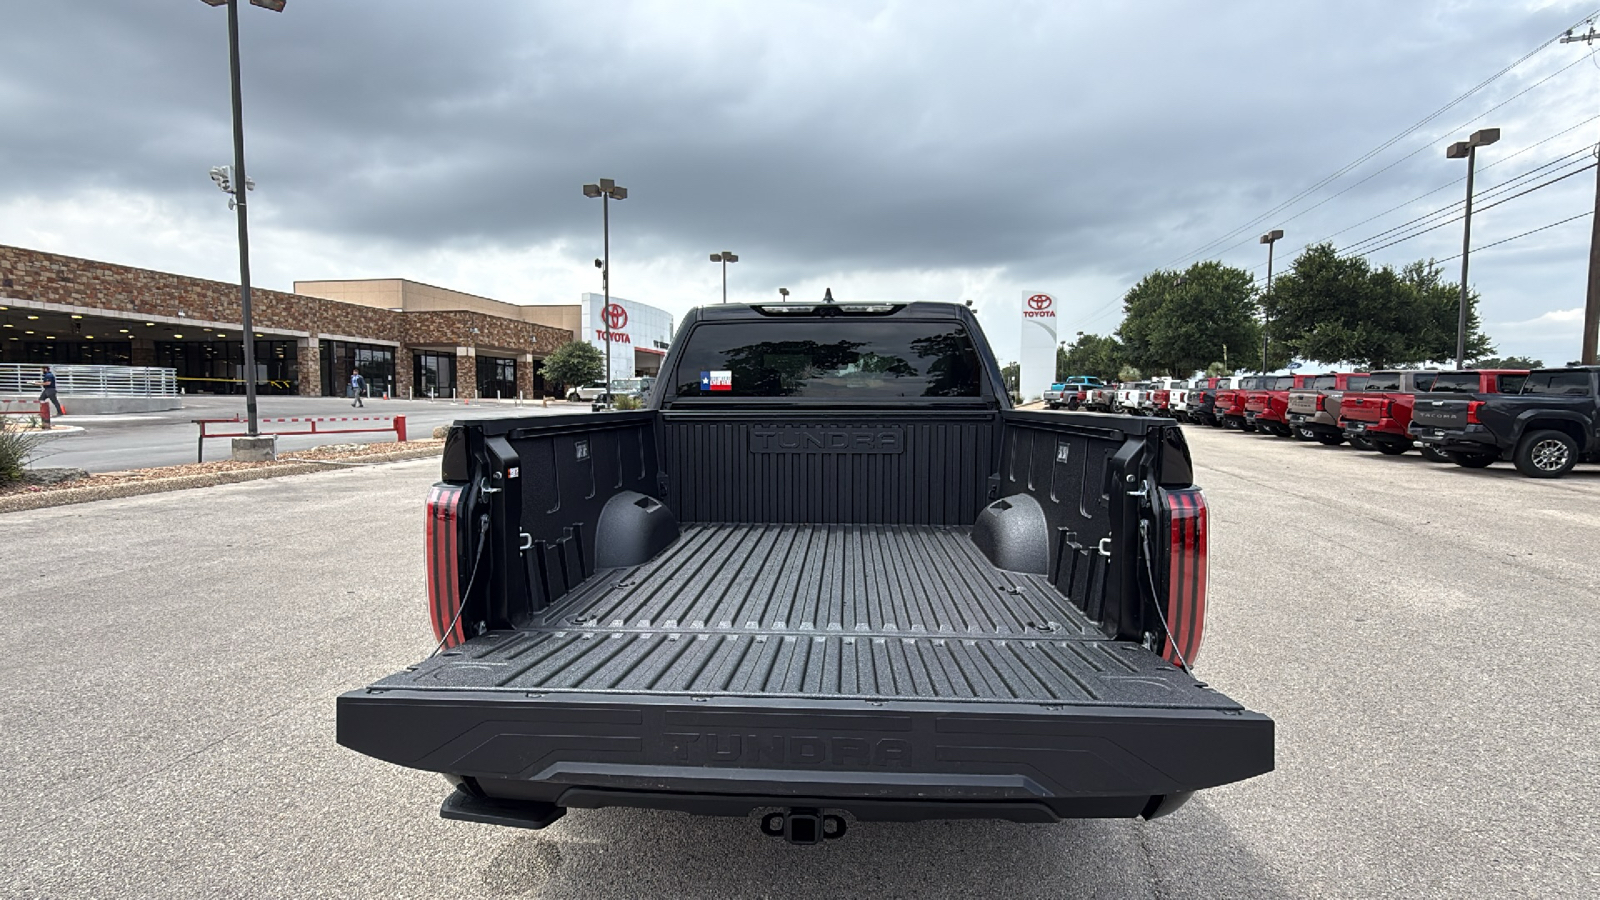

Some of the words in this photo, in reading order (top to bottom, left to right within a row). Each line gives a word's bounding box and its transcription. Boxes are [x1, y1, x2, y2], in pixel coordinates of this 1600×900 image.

[1023, 310, 1056, 318] TOYOTA
[754, 431, 900, 450] TUNDRA
[663, 732, 912, 768] TUNDRA
